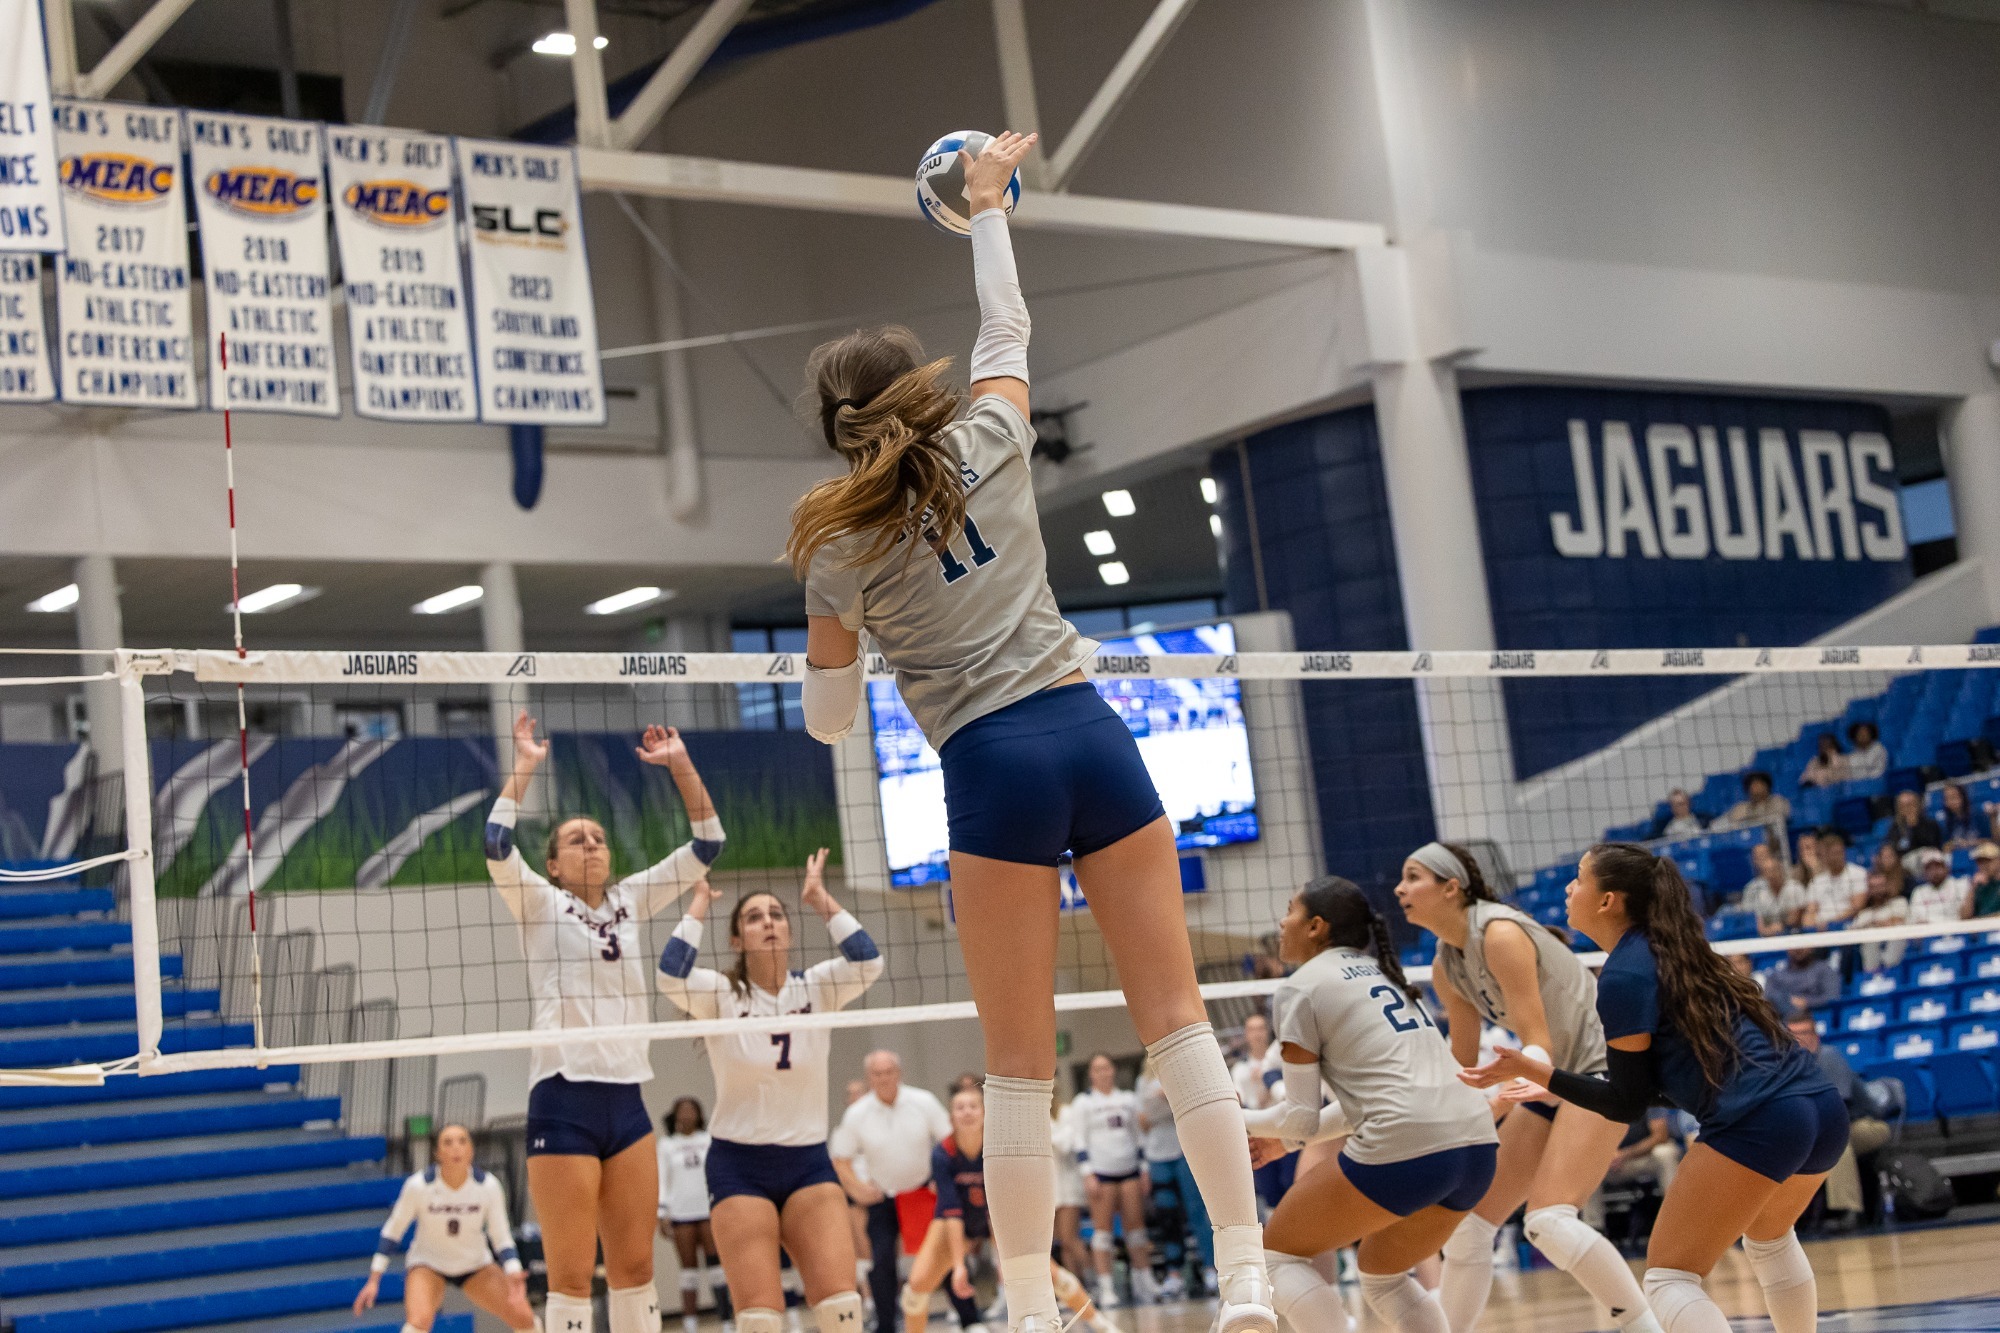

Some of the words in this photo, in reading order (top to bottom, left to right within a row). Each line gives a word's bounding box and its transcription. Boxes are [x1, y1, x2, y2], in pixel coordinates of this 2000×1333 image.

[126, 113, 174, 143] GOLF
[267, 127, 313, 156] GOLF
[403, 140, 443, 170] GOLF
[67, 156, 174, 194] MEAC
[216, 175, 318, 207] MEAC
[354, 183, 448, 217] MEAC
[472, 204, 562, 238] SLC
[96, 224, 146, 253] 2017
[65, 259, 190, 292] MID-EASTERN
[213, 269, 327, 299] MID-EASTERN
[345, 281, 457, 311] MID-EASTERN
[85, 296, 173, 327] ATHLETIC
[229, 306, 318, 334] ATHLETIC
[492, 307, 580, 340] SOUTHLAND
[366, 316, 447, 344] ATHLETIC
[67, 331, 192, 362] CONFERENCE
[493, 346, 586, 377] CONFERENCE
[360, 349, 466, 378] CONFERENCE
[78, 367, 186, 399] CHAMPIONS
[227, 374, 327, 405] CHAMPIONS
[367, 383, 465, 412] CHAMPIONS
[492, 383, 594, 413] CHAMPIONS
[1549, 418, 1905, 562] JAGUARS
[343, 655, 418, 676] JAGUARS
[619, 655, 687, 676] JAGUARS
[1095, 655, 1150, 674] JAGUARS
[1300, 653, 1352, 672] JAGUARS
[1489, 651, 1535, 669] JAGUARS
[1661, 649, 1704, 667] JAGUARS
[1819, 647, 1861, 664] JAGUARS
[770, 1033, 791, 1070] 7
